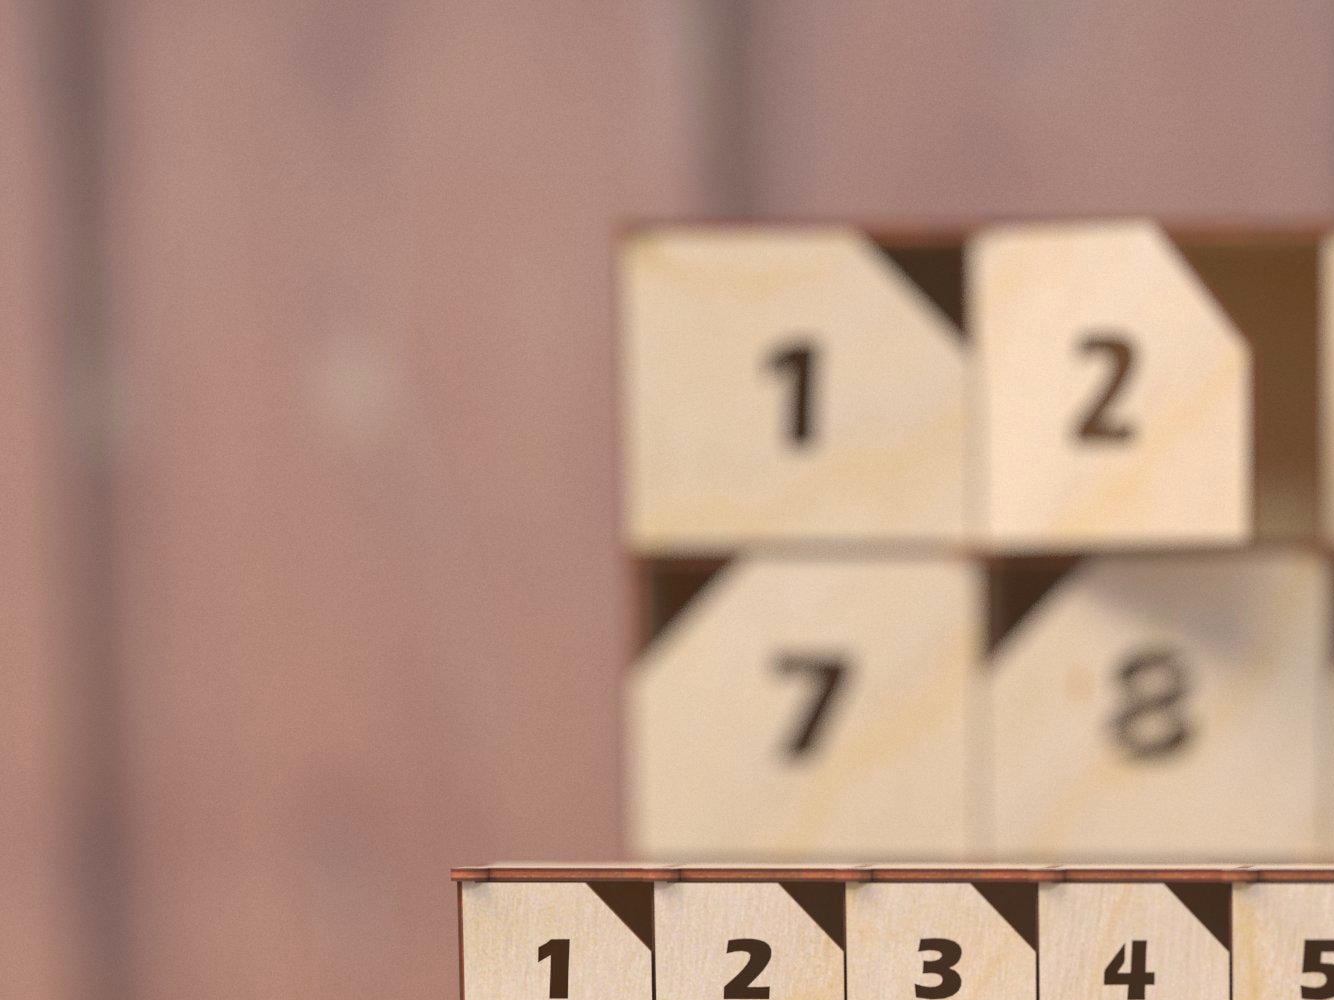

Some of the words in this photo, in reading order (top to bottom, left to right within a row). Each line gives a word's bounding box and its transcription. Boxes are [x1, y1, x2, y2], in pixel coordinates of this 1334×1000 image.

[760, 338, 820, 449] 1
[1072, 331, 1142, 447] 2
[771, 653, 855, 762] 7
[1108, 643, 1199, 763] 8
[538, 939, 570, 999] 1
[724, 939, 771, 999] 2
[915, 938, 962, 999] 3
[1104, 940, 1154, 1000] 4
